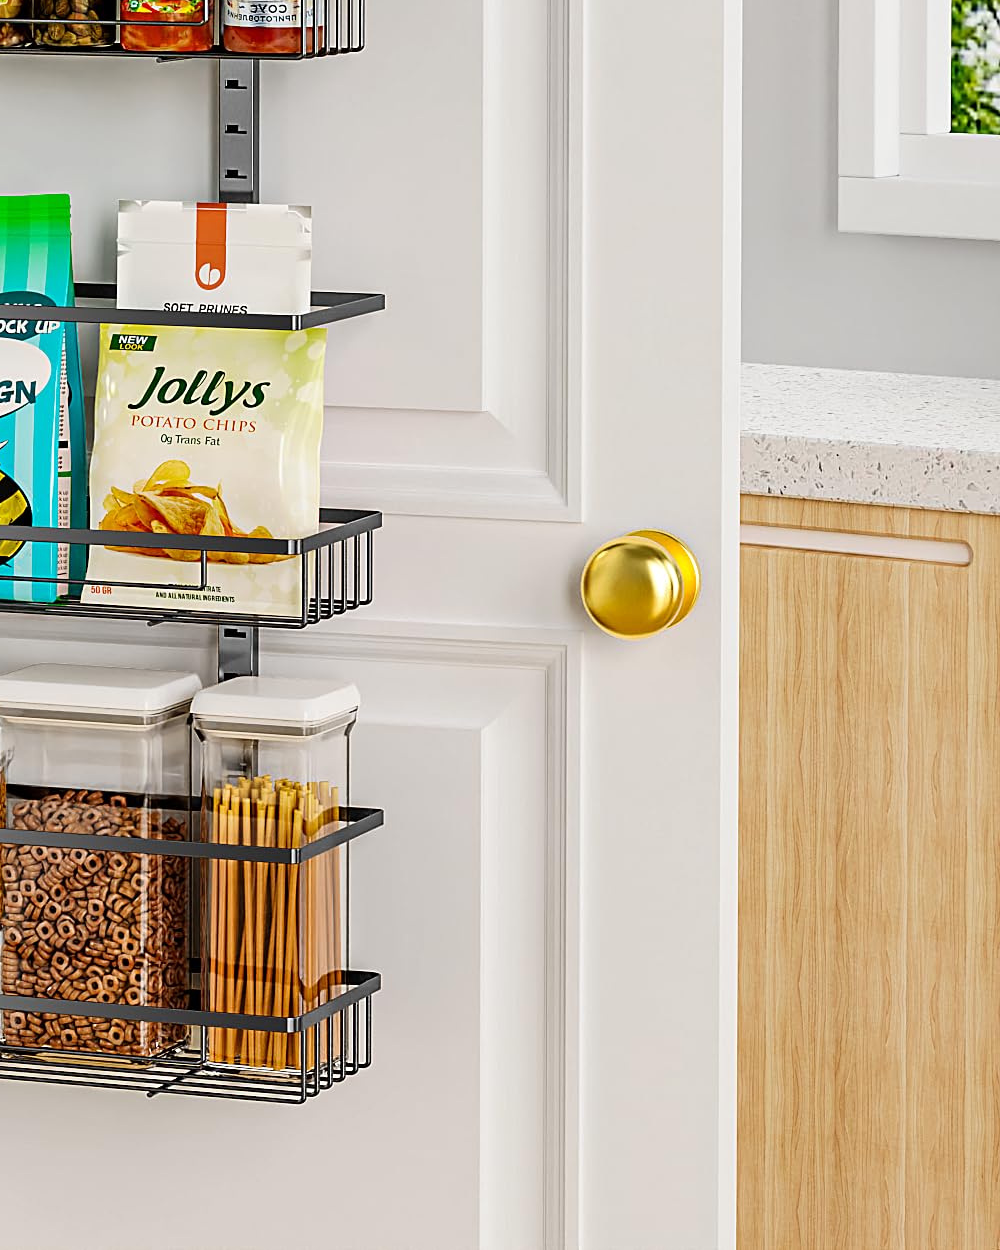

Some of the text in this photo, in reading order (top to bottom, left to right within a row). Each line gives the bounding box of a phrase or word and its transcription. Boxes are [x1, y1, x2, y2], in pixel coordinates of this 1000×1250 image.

[163, 303, 248, 315] SOFT PRUNES
[34, 319, 61, 334] UP
[118, 335, 148, 345] NEW
[127, 366, 271, 416] Jollys
[131, 415, 256, 433] POTATO CHIPS
[160, 434, 220, 446] 0g Trans Fat
[90, 585, 100, 594] 50
[102, 586, 112, 595] GR
[177, 593, 201, 601] NATURAL
[202, 595, 235, 603] INGREDIENTS
